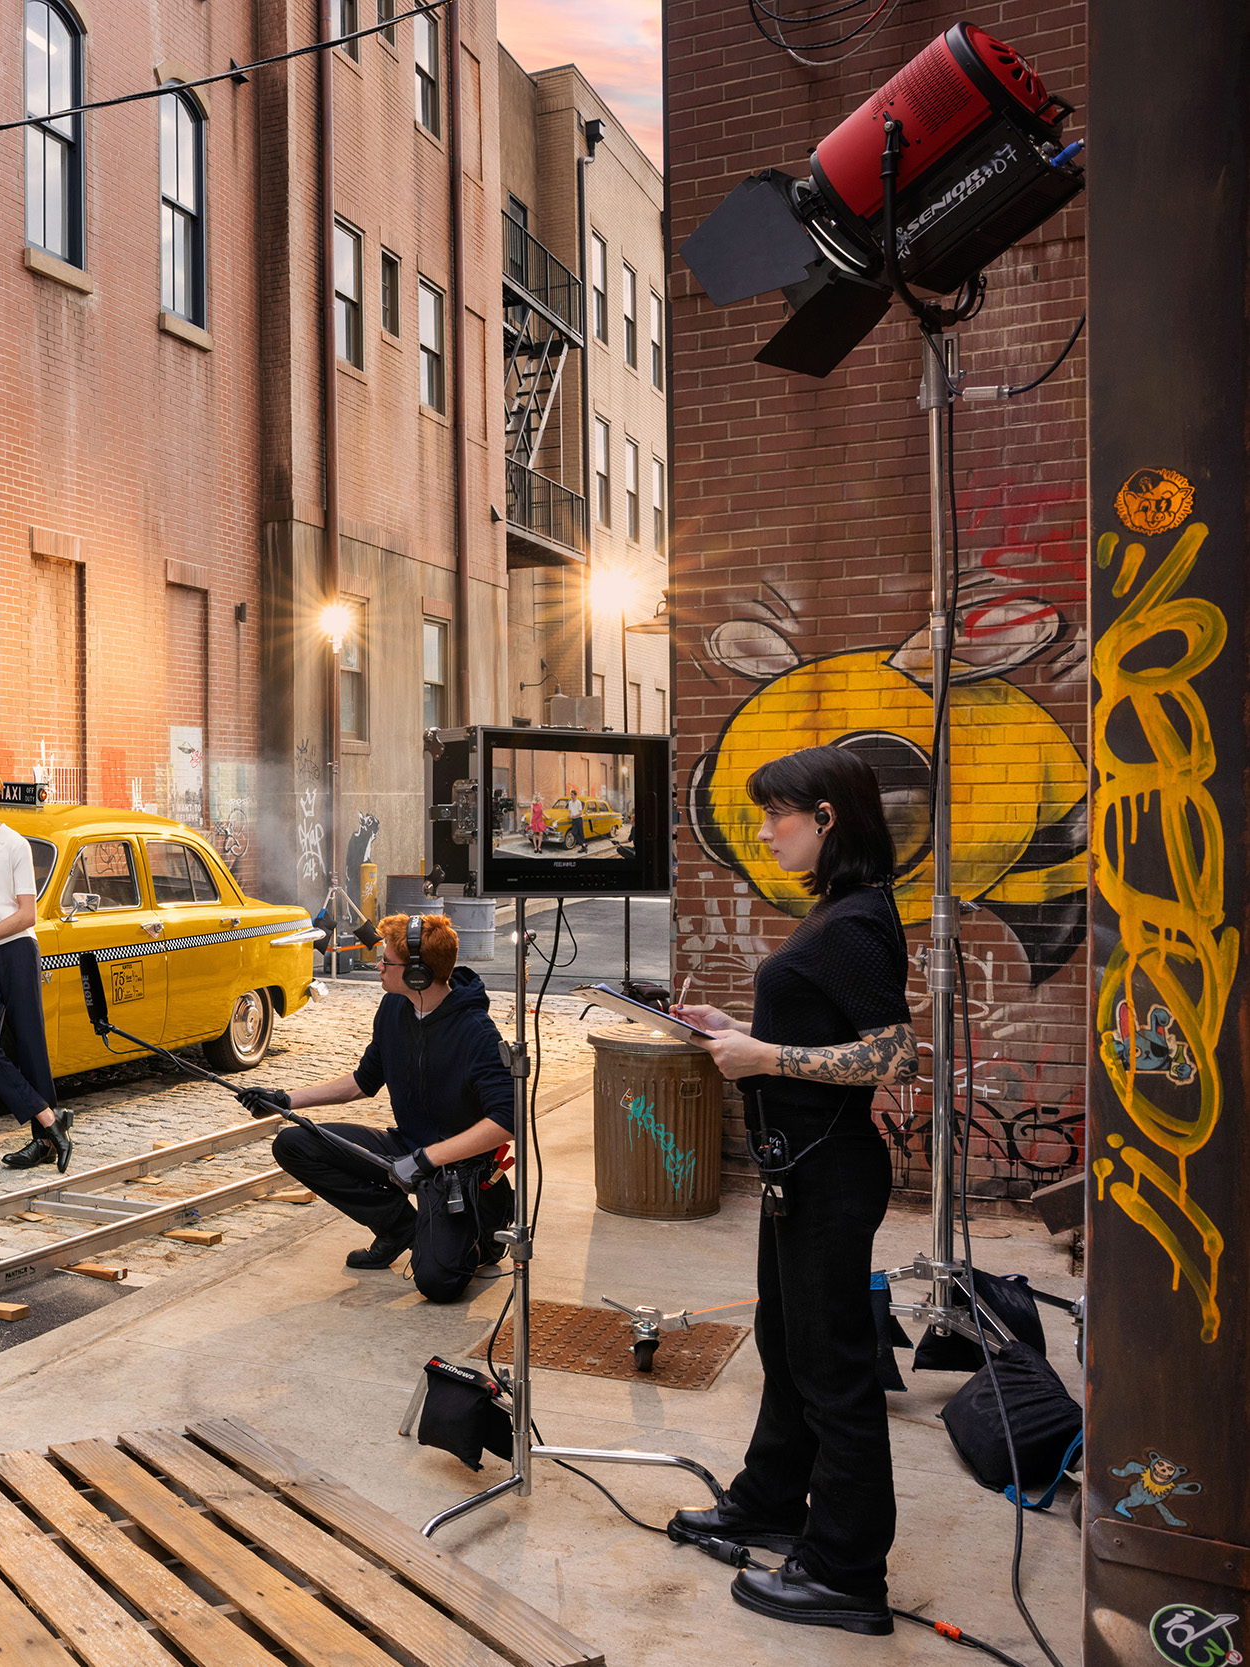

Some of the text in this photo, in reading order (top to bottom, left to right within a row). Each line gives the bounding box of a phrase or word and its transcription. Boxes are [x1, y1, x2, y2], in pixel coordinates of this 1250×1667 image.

[907, 168, 981, 232] SENIOR
[960, 176, 986, 201] LED
[430, 1360, 475, 1380] matthews
